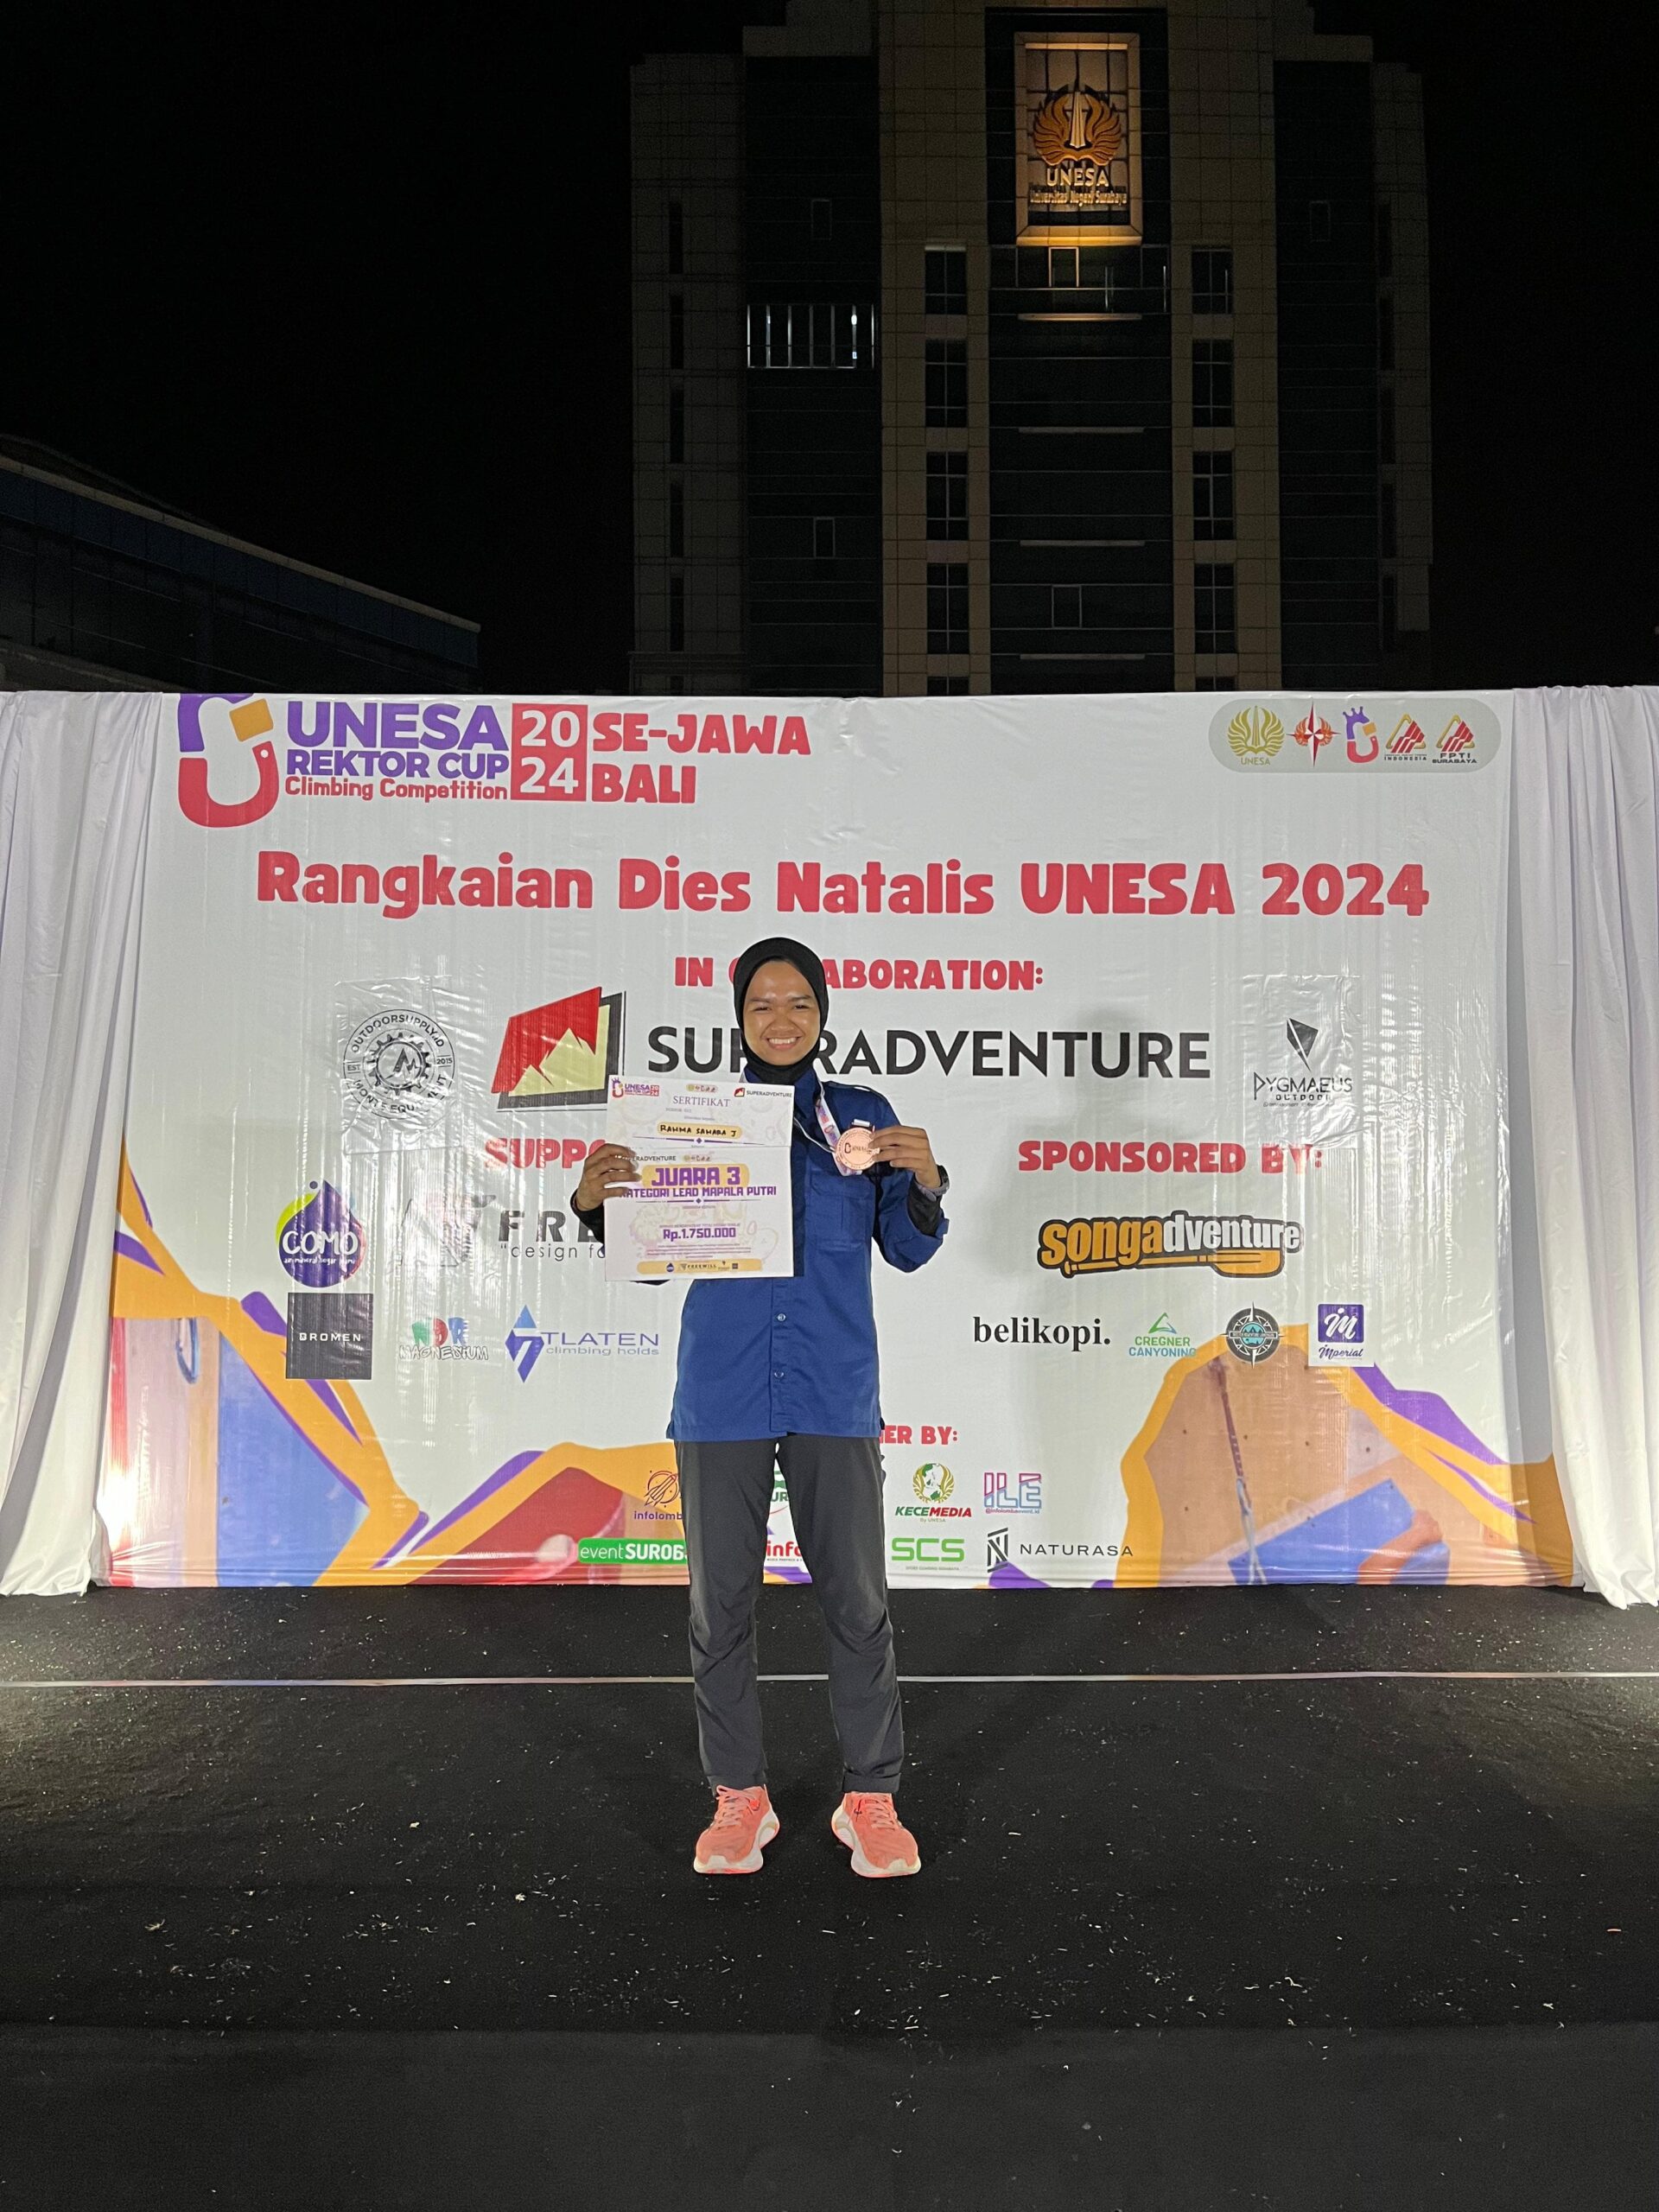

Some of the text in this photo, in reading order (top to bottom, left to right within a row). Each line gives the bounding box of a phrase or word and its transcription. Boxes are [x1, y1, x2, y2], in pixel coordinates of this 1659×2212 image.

[1046, 168, 1109, 187] UNESA
[287, 700, 510, 752] UNESA
[520, 709, 578, 749] 20
[592, 712, 811, 756] SE-JAWA
[287, 749, 510, 780] REKTOR CUP
[1240, 757, 1271, 766] UNESA
[520, 755, 579, 795] 24
[592, 763, 696, 805] BALI
[285, 776, 509, 801] Climbing Competition
[257, 850, 1430, 919] Rangkaian Dies Natalis UNESA 2024
[674, 957, 1044, 991] IN ABORATION:
[647, 1025, 1211, 1079] SURADVENTURE
[1253, 1071, 1353, 1101] PYGMAEUS
[672, 1095, 731, 1108] SERTIFIKAT
[659, 1124, 692, 1134] RAHMA
[696, 1127, 727, 1136] SAHARA
[1018, 1140, 1322, 1174] SPONSORED BY:
[652, 1166, 741, 1186] JUARA 3
[672, 1187, 699, 1198] LEAD
[702, 1186, 744, 1197] MAPALA
[747, 1185, 777, 1196] PUTRI
[282, 1230, 359, 1255] COMO
[663, 1227, 736, 1242] Rp.1.750.000
[1039, 1213, 1302, 1267] songadventure
[299, 1332, 361, 1342] BROMEN
[972, 1316, 1111, 1352] belikopi.
[1134, 1336, 1191, 1347] CREGNER
[398, 1344, 489, 1361] MAGNESIUM
[545, 1345, 659, 1357] climbing holds
[1128, 1346, 1197, 1358] CANYONING
[921, 1425, 958, 1446] BY:
[983, 1472, 1042, 1510] ILE
[894, 1505, 973, 1518] KECEMEDIA
[580, 1542, 688, 1560] eventSUROB
[891, 1537, 966, 1563] SCS
[1020, 1543, 1134, 1557] NATURASA
